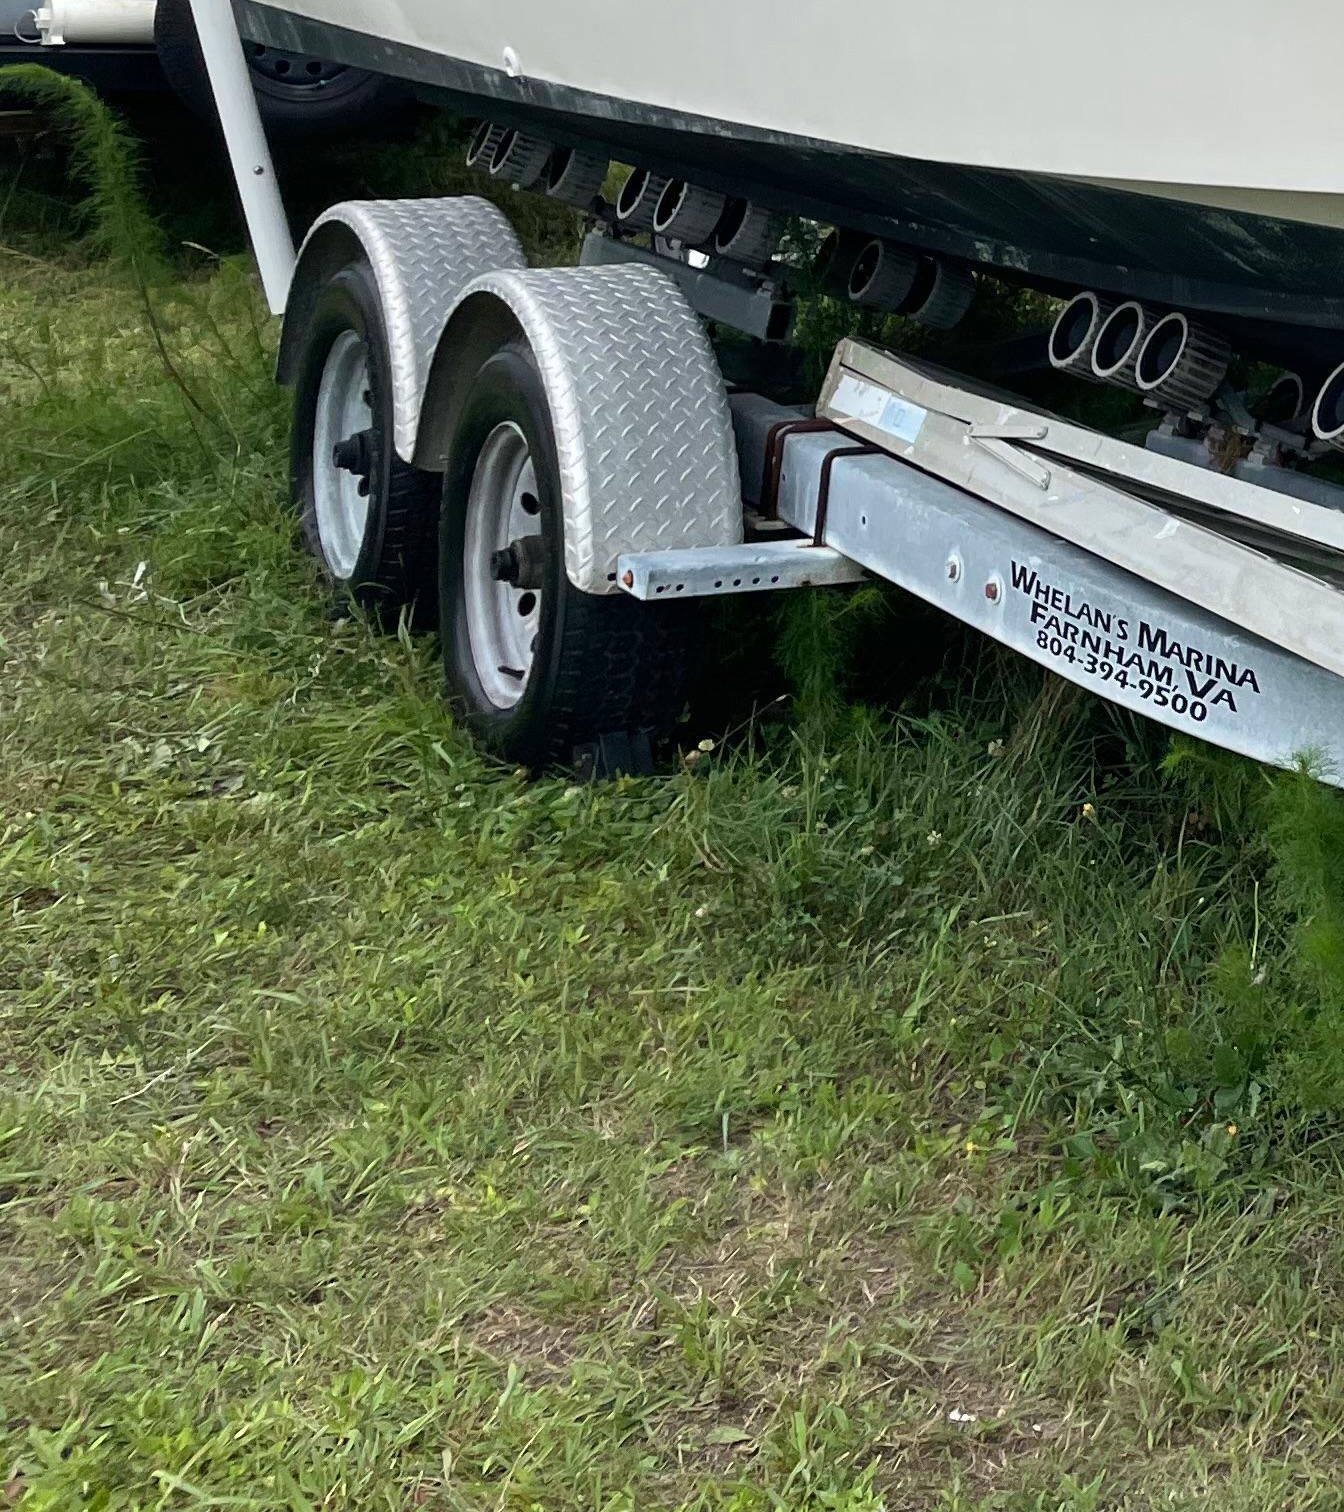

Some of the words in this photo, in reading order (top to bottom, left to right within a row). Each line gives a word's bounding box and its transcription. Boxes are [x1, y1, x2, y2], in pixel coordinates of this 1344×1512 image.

[1011, 560, 1129, 641] WHELAN'S
[1137, 621, 1261, 694] MARINA
[1030, 600, 1179, 693] FARNHAM,
[1185, 669, 1238, 713] VA
[1036, 630, 1208, 722] 804-394-9500
